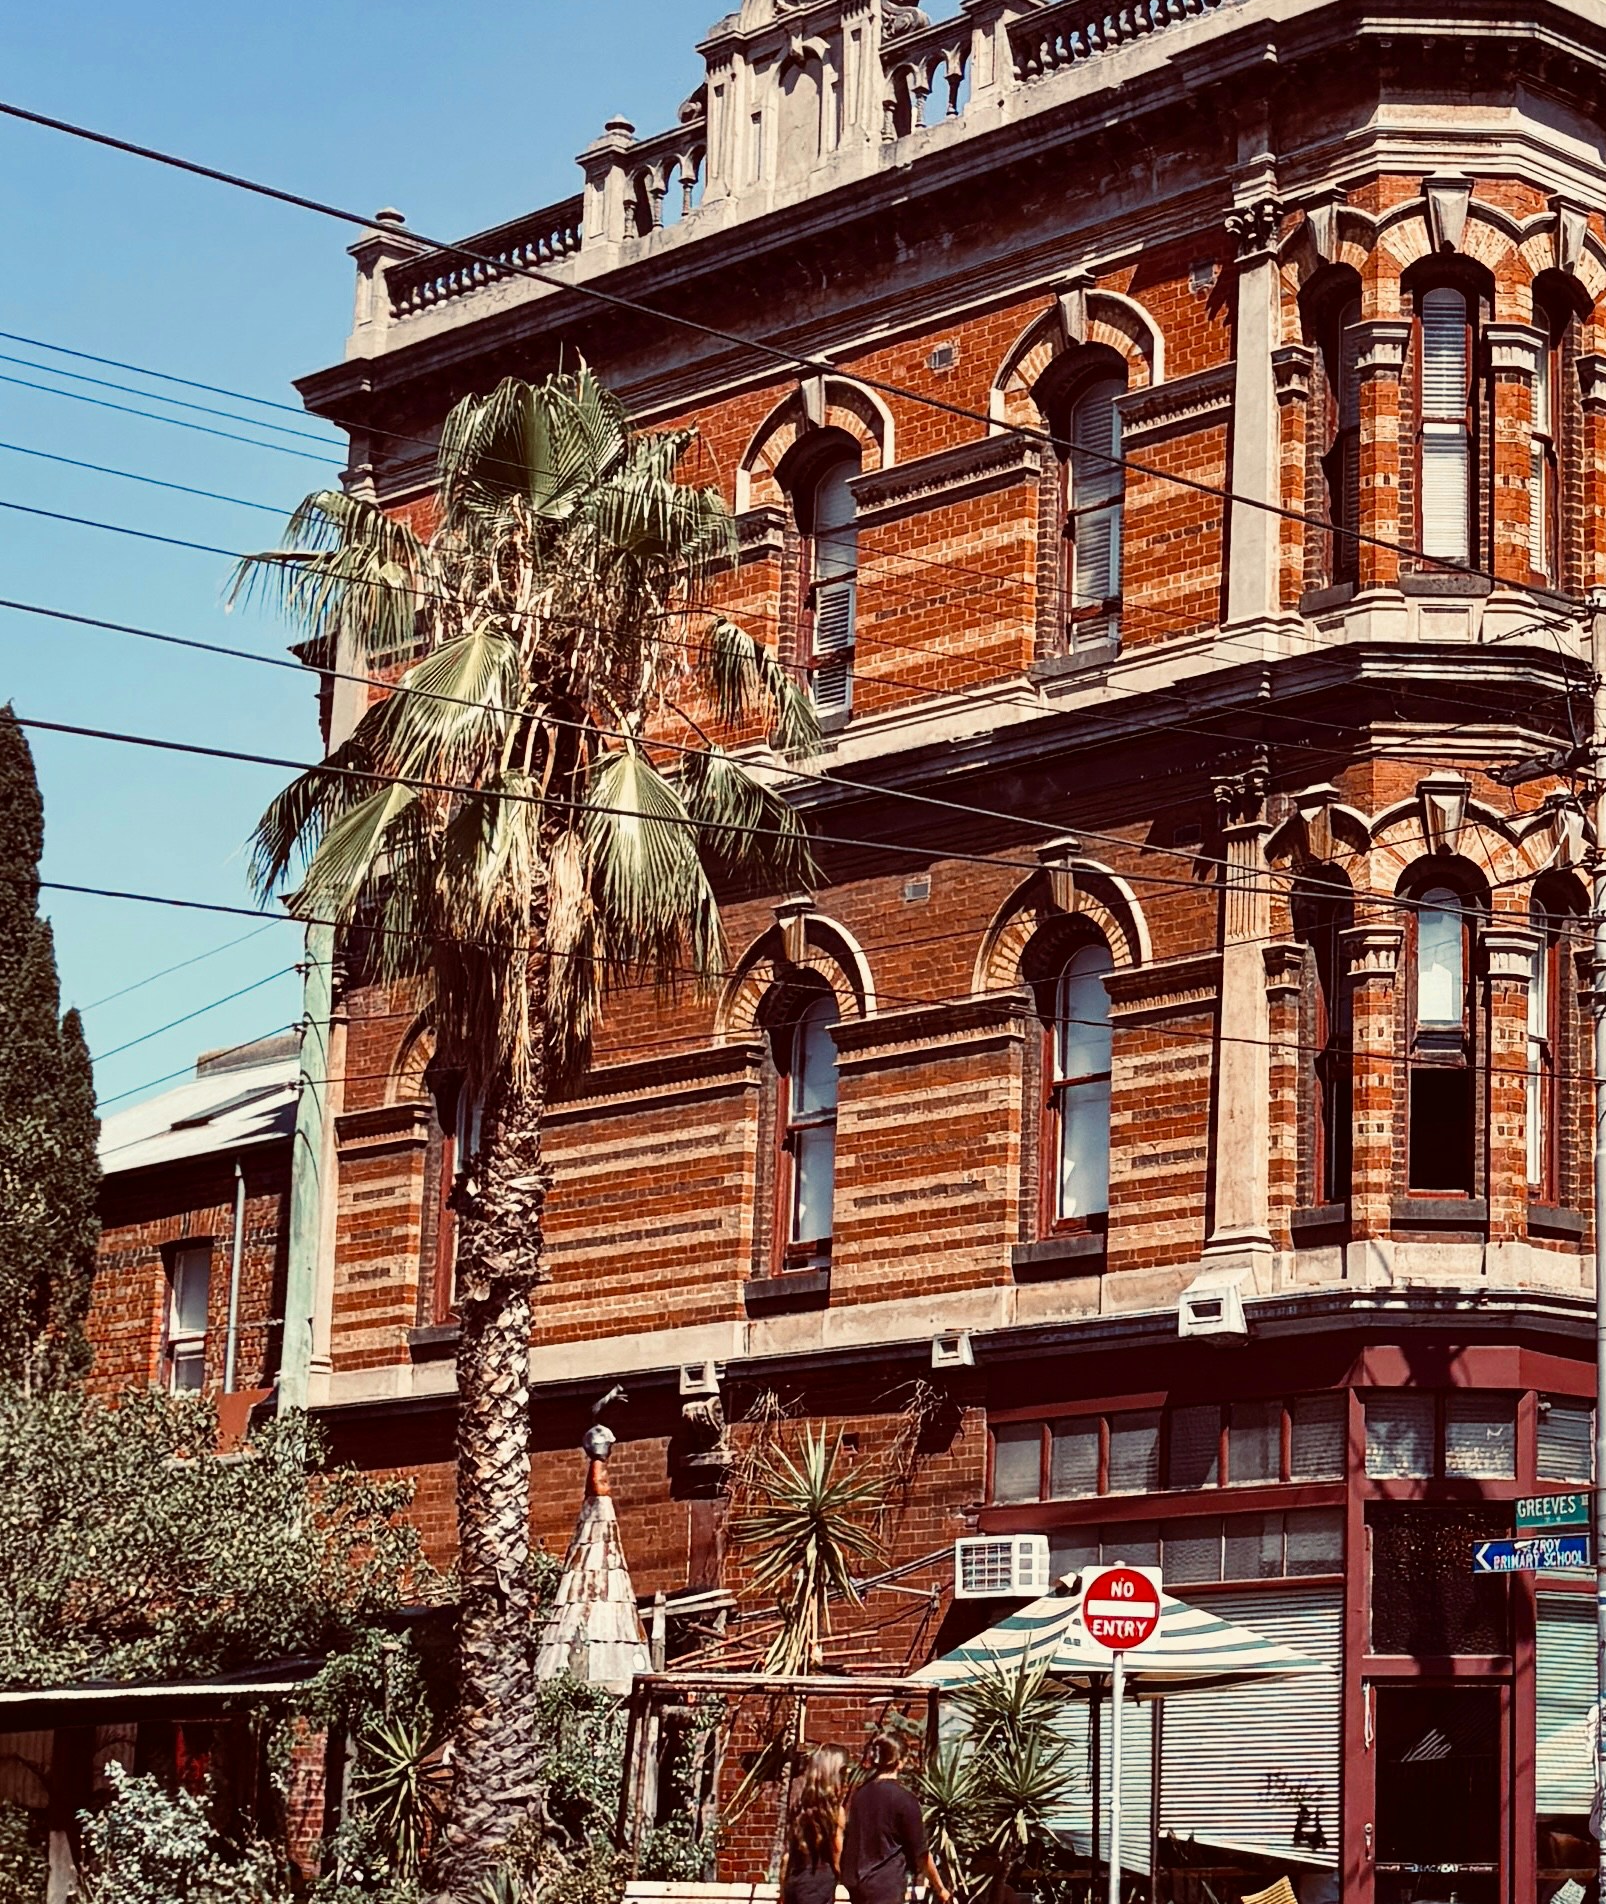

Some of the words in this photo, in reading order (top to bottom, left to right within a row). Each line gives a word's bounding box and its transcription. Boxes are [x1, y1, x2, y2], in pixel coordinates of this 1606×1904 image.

[1517, 1496, 1576, 1517] GREEVES
[1493, 1553, 1540, 1570] PRIMARY
[1544, 1550, 1585, 1567] SCHOOL
[1110, 1581, 1135, 1598] NO
[1092, 1619, 1148, 1638] ENTRY
